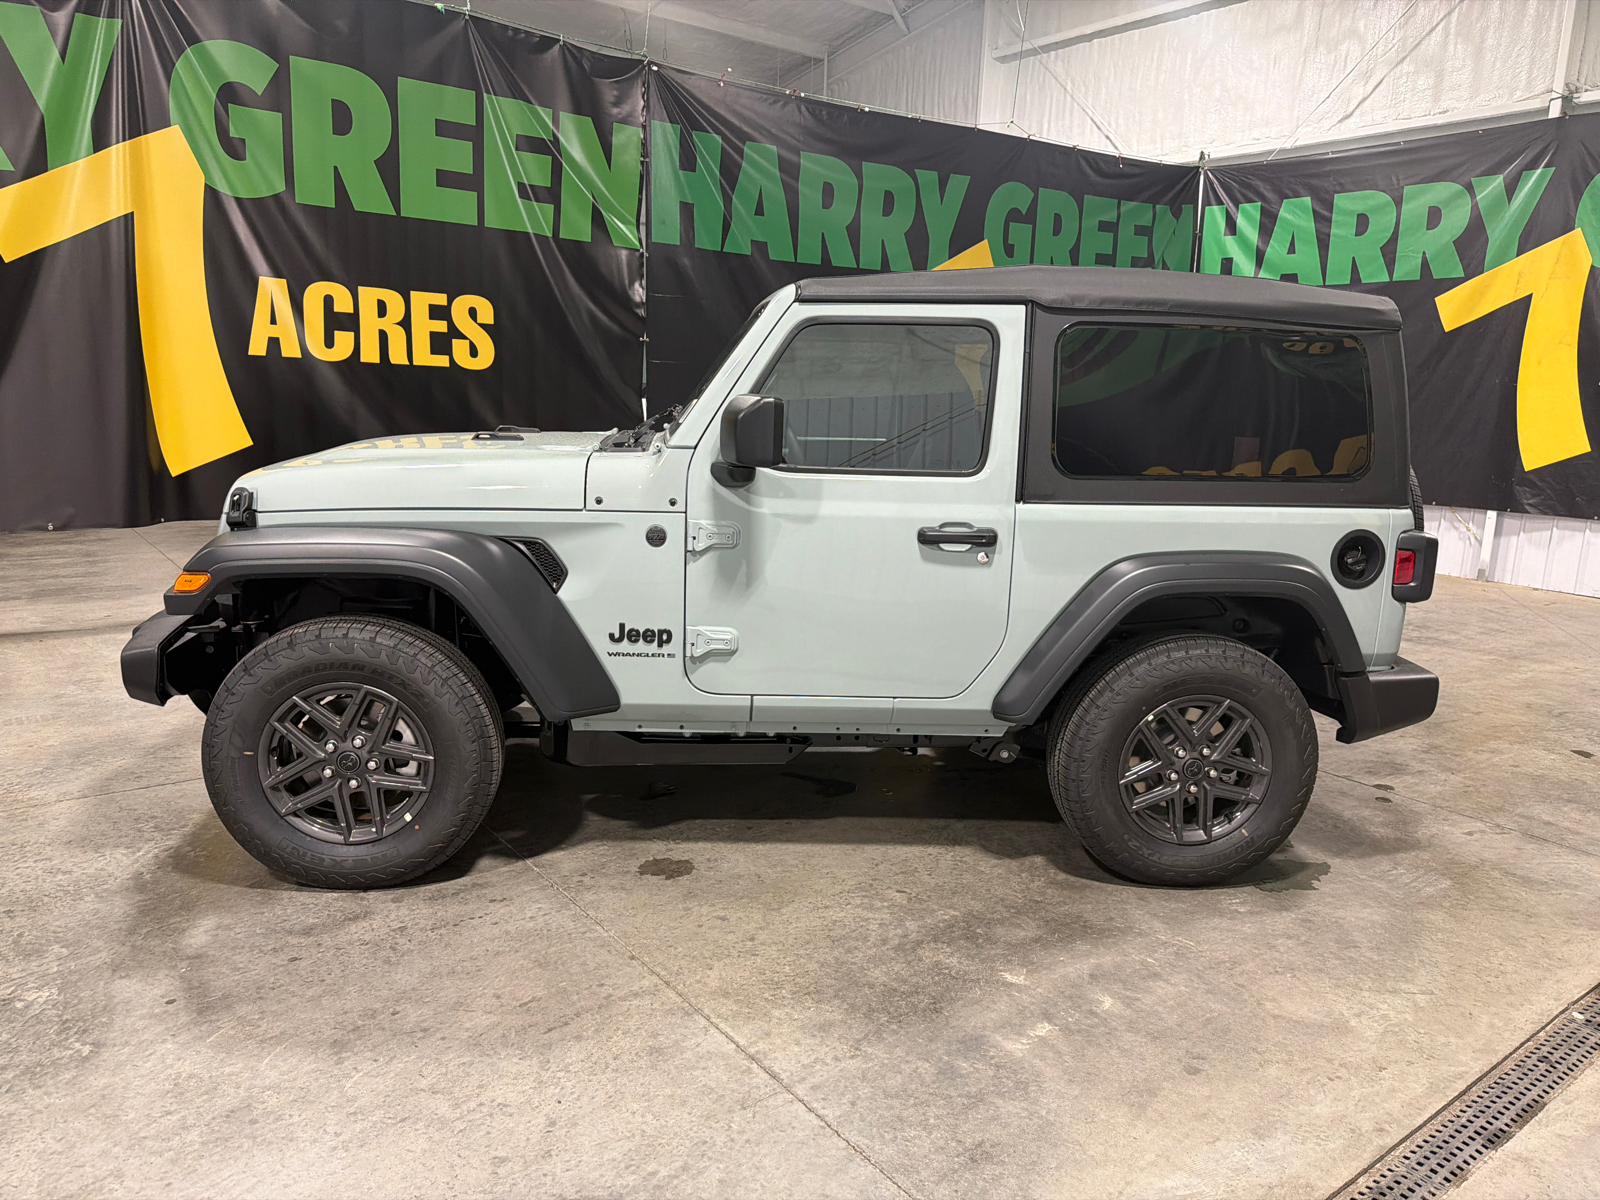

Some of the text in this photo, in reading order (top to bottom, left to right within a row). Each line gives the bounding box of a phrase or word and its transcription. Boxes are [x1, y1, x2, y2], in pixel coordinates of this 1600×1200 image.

[169, 39, 642, 249] GREEN
[651, 119, 1194, 272] HARRY GREEN
[0, 124, 253, 477] 7
[1200, 167, 1556, 286] HARRY
[248, 275, 496, 371] ACRES
[1434, 227, 1593, 472] 7
[608, 622, 673, 648] Jeep
